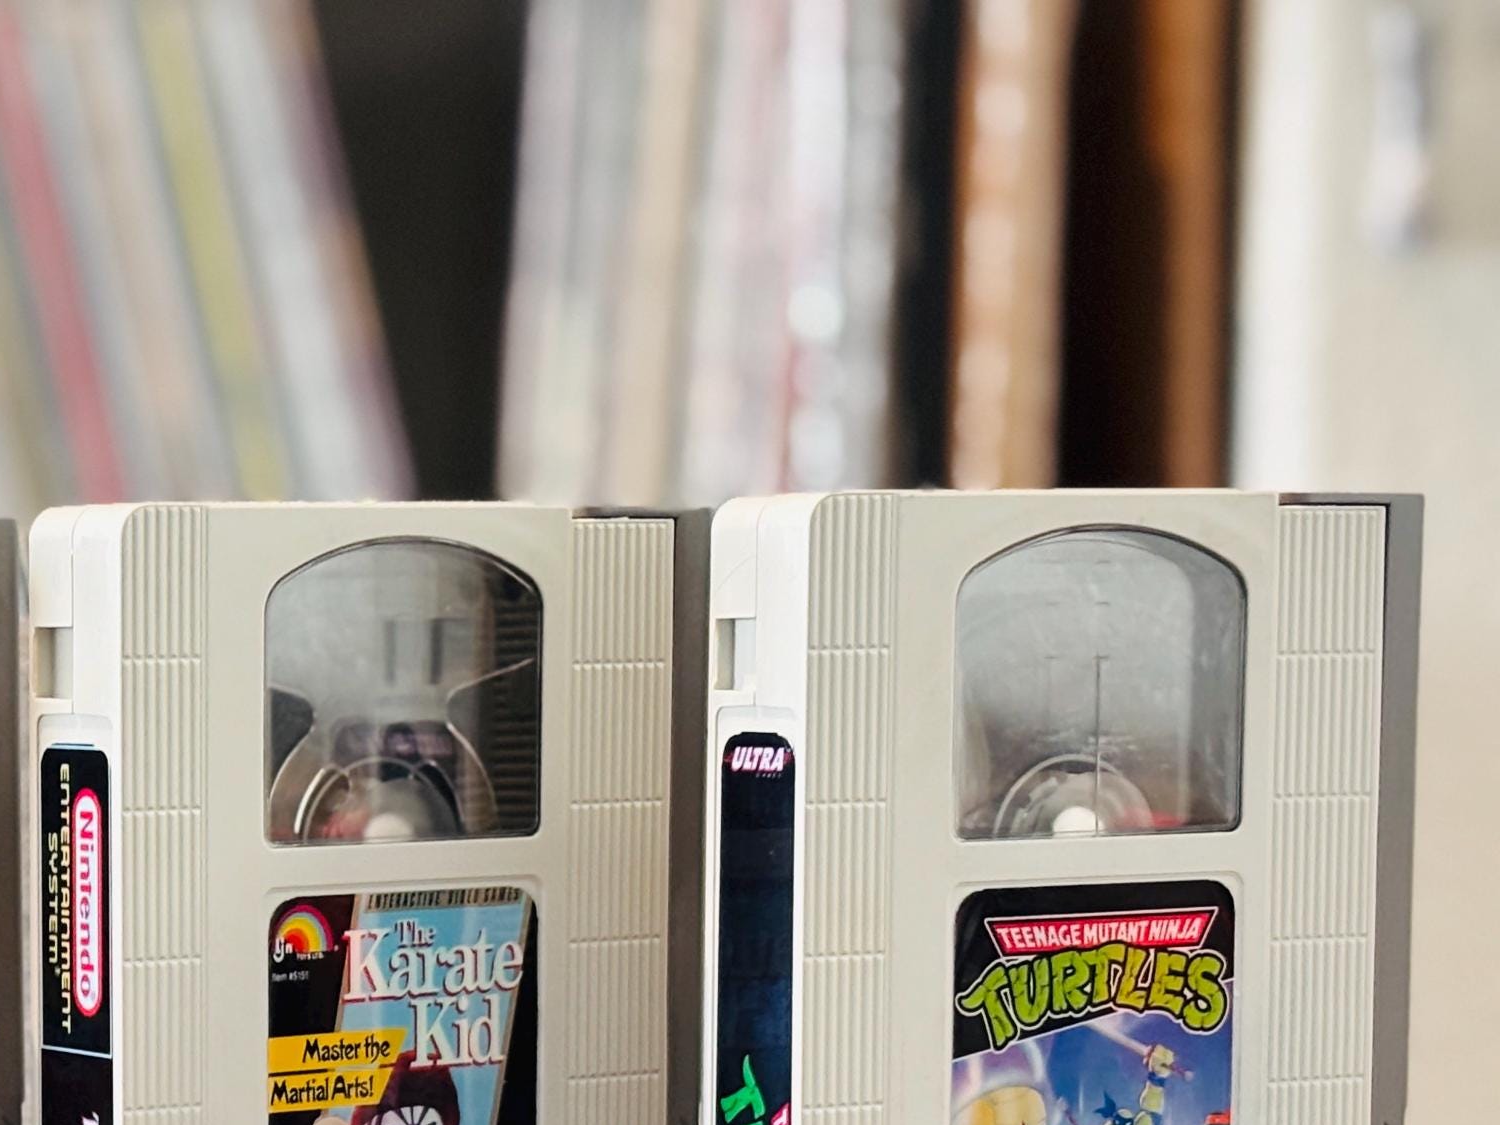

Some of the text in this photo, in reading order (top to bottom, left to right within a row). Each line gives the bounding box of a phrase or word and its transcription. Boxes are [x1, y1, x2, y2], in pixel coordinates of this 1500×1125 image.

[730, 745, 785, 772] ULTRA
[48, 832, 58, 963] SYSTEM
[60, 763, 71, 1034] ENTERTAINMENT
[79, 810, 94, 998] Nintendo
[393, 918, 435, 948] The
[996, 917, 1202, 949] TEENAGE MUTANT NINJA
[341, 927, 524, 1005] Karate
[958, 942, 1227, 1049] TURTLES
[302, 1033, 390, 1063] Master the
[409, 993, 506, 1070] Kid
[271, 1074, 374, 1105] Martial Arts!
